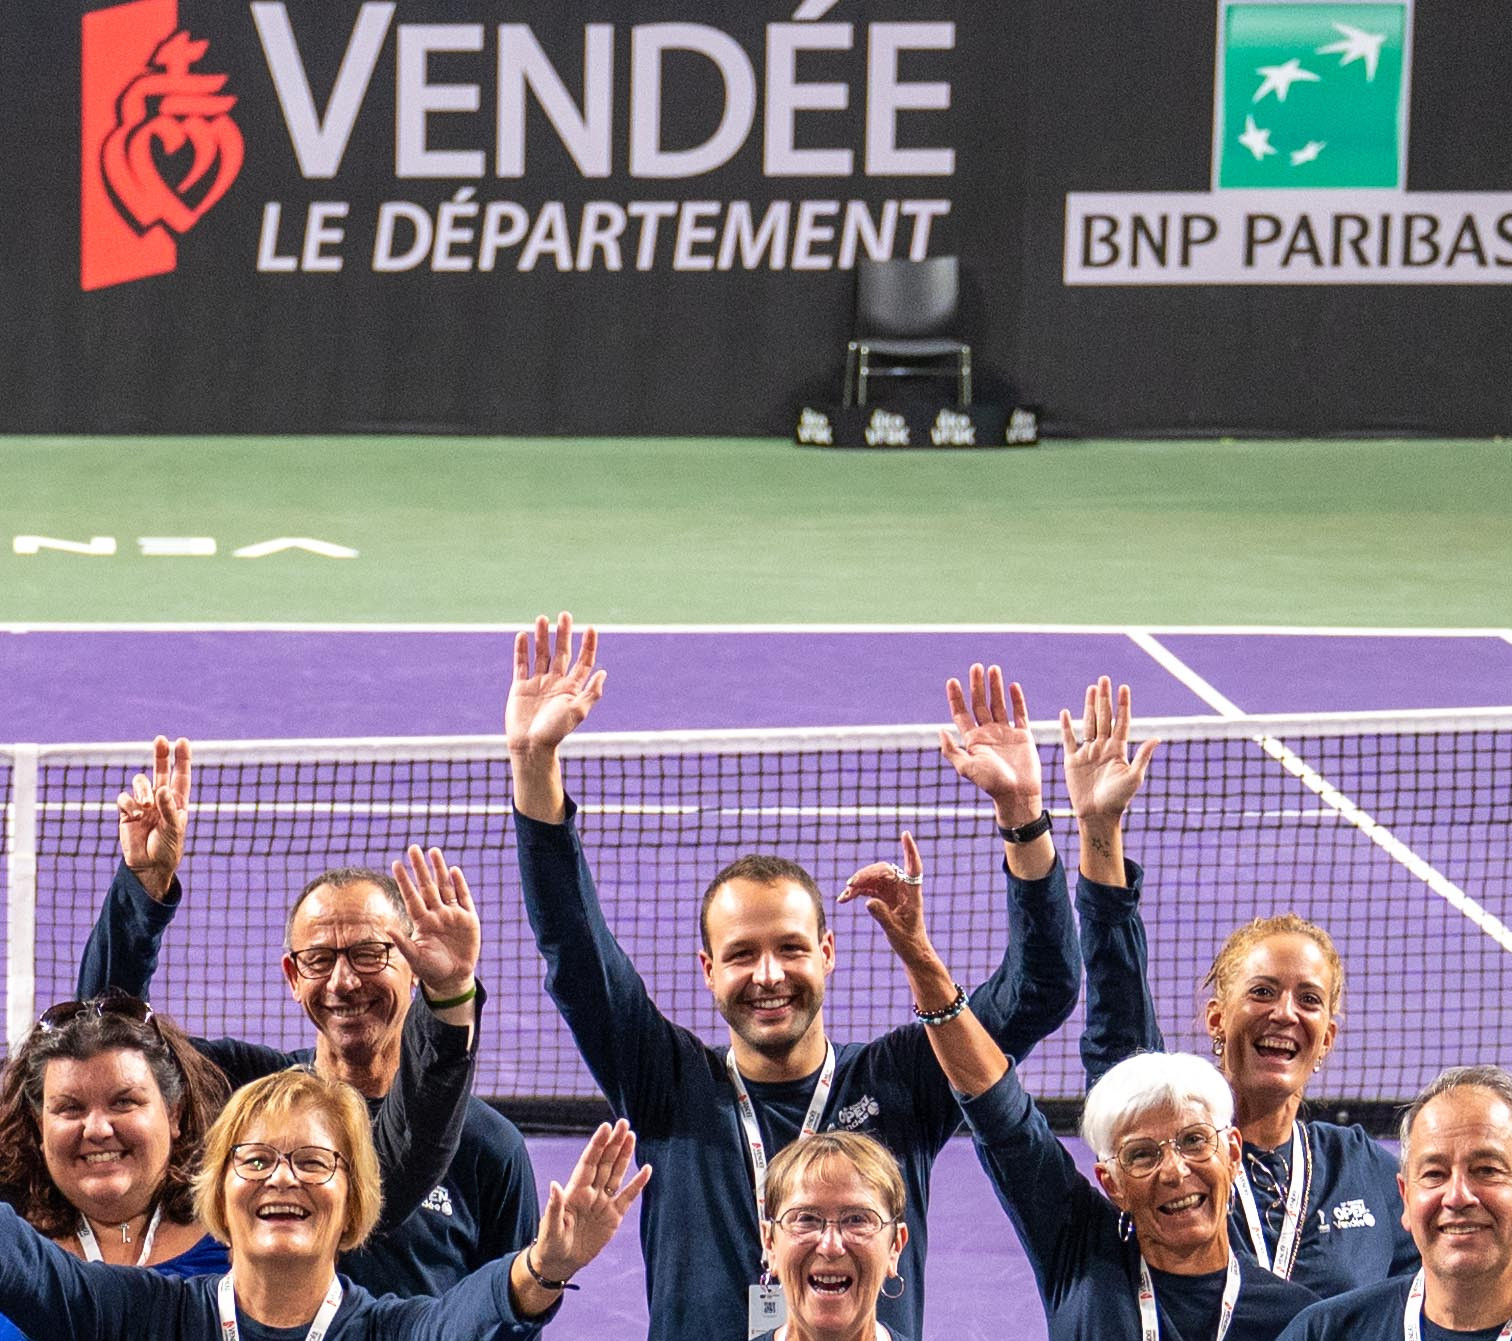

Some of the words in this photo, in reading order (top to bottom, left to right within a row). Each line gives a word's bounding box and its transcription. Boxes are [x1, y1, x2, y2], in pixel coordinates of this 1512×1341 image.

[252, 0, 956, 179] VENDÉE
[257, 201, 349, 271] LE
[372, 189, 951, 272] DÉPARTEMENT
[1080, 213, 1219, 270] BNP
